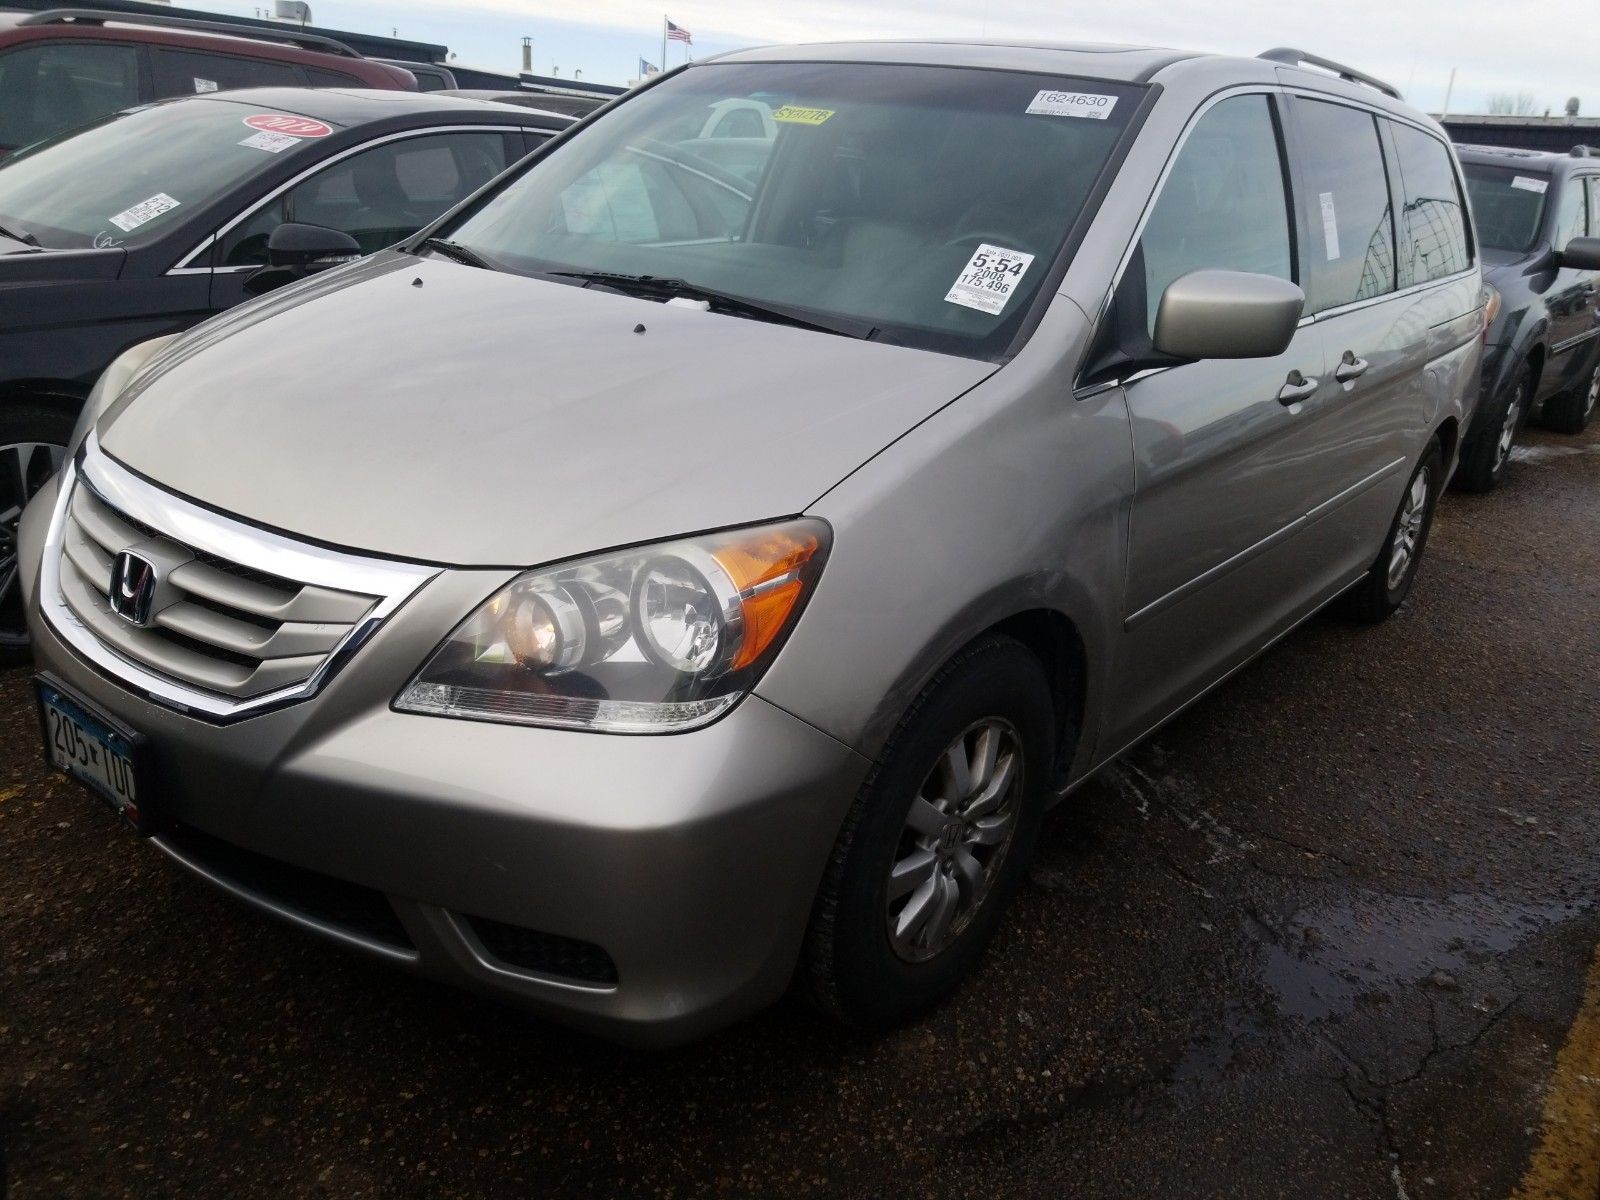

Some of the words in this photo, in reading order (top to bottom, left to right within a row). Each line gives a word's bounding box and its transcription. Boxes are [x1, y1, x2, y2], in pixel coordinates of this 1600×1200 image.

[1040, 93, 1108, 107] 1624630
[973, 253, 1024, 277] 5:54
[974, 268, 1006, 282] 2008
[961, 274, 1010, 294] 175,496
[50, 707, 89, 766] 205
